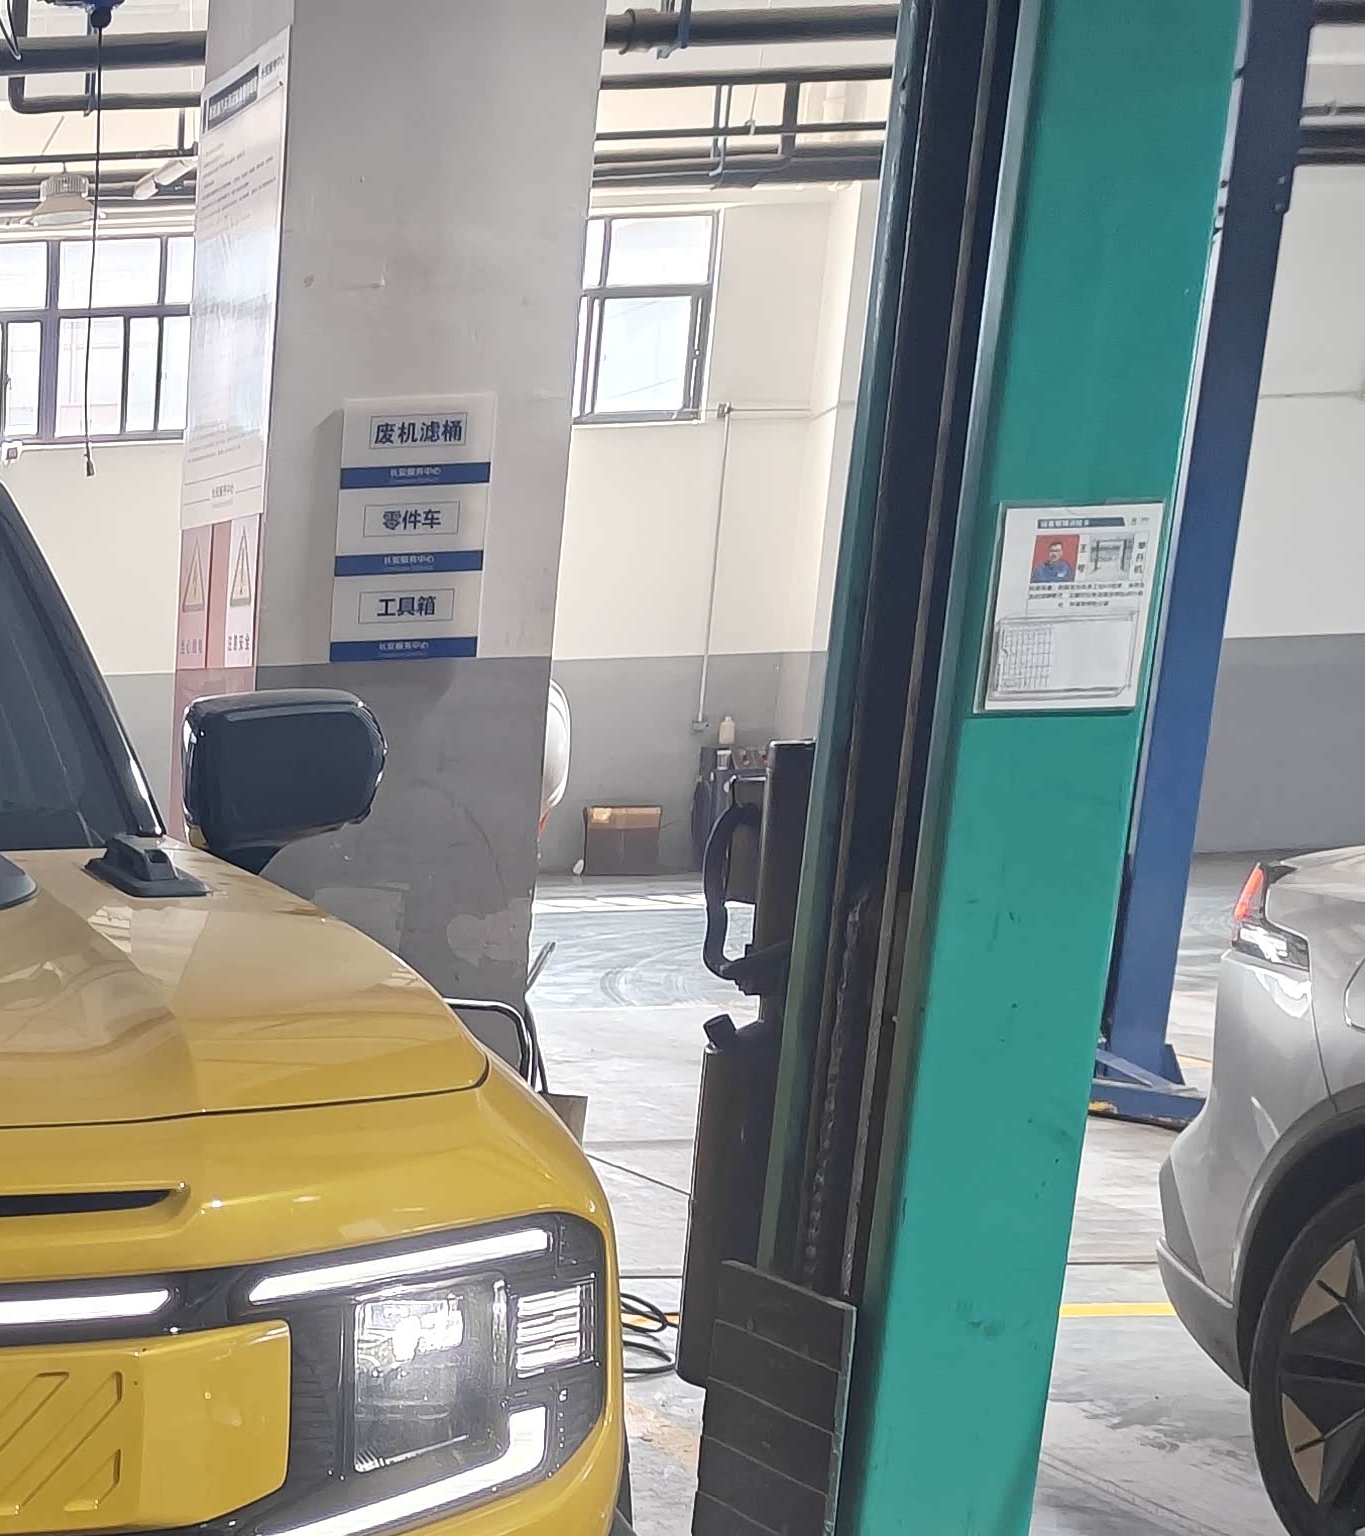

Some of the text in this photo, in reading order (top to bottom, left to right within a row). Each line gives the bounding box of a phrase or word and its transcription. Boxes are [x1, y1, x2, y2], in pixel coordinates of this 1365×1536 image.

[374, 419, 463, 445] 废机滤桶
[382, 508, 442, 531] 零件车
[377, 595, 437, 617] 工具箱
